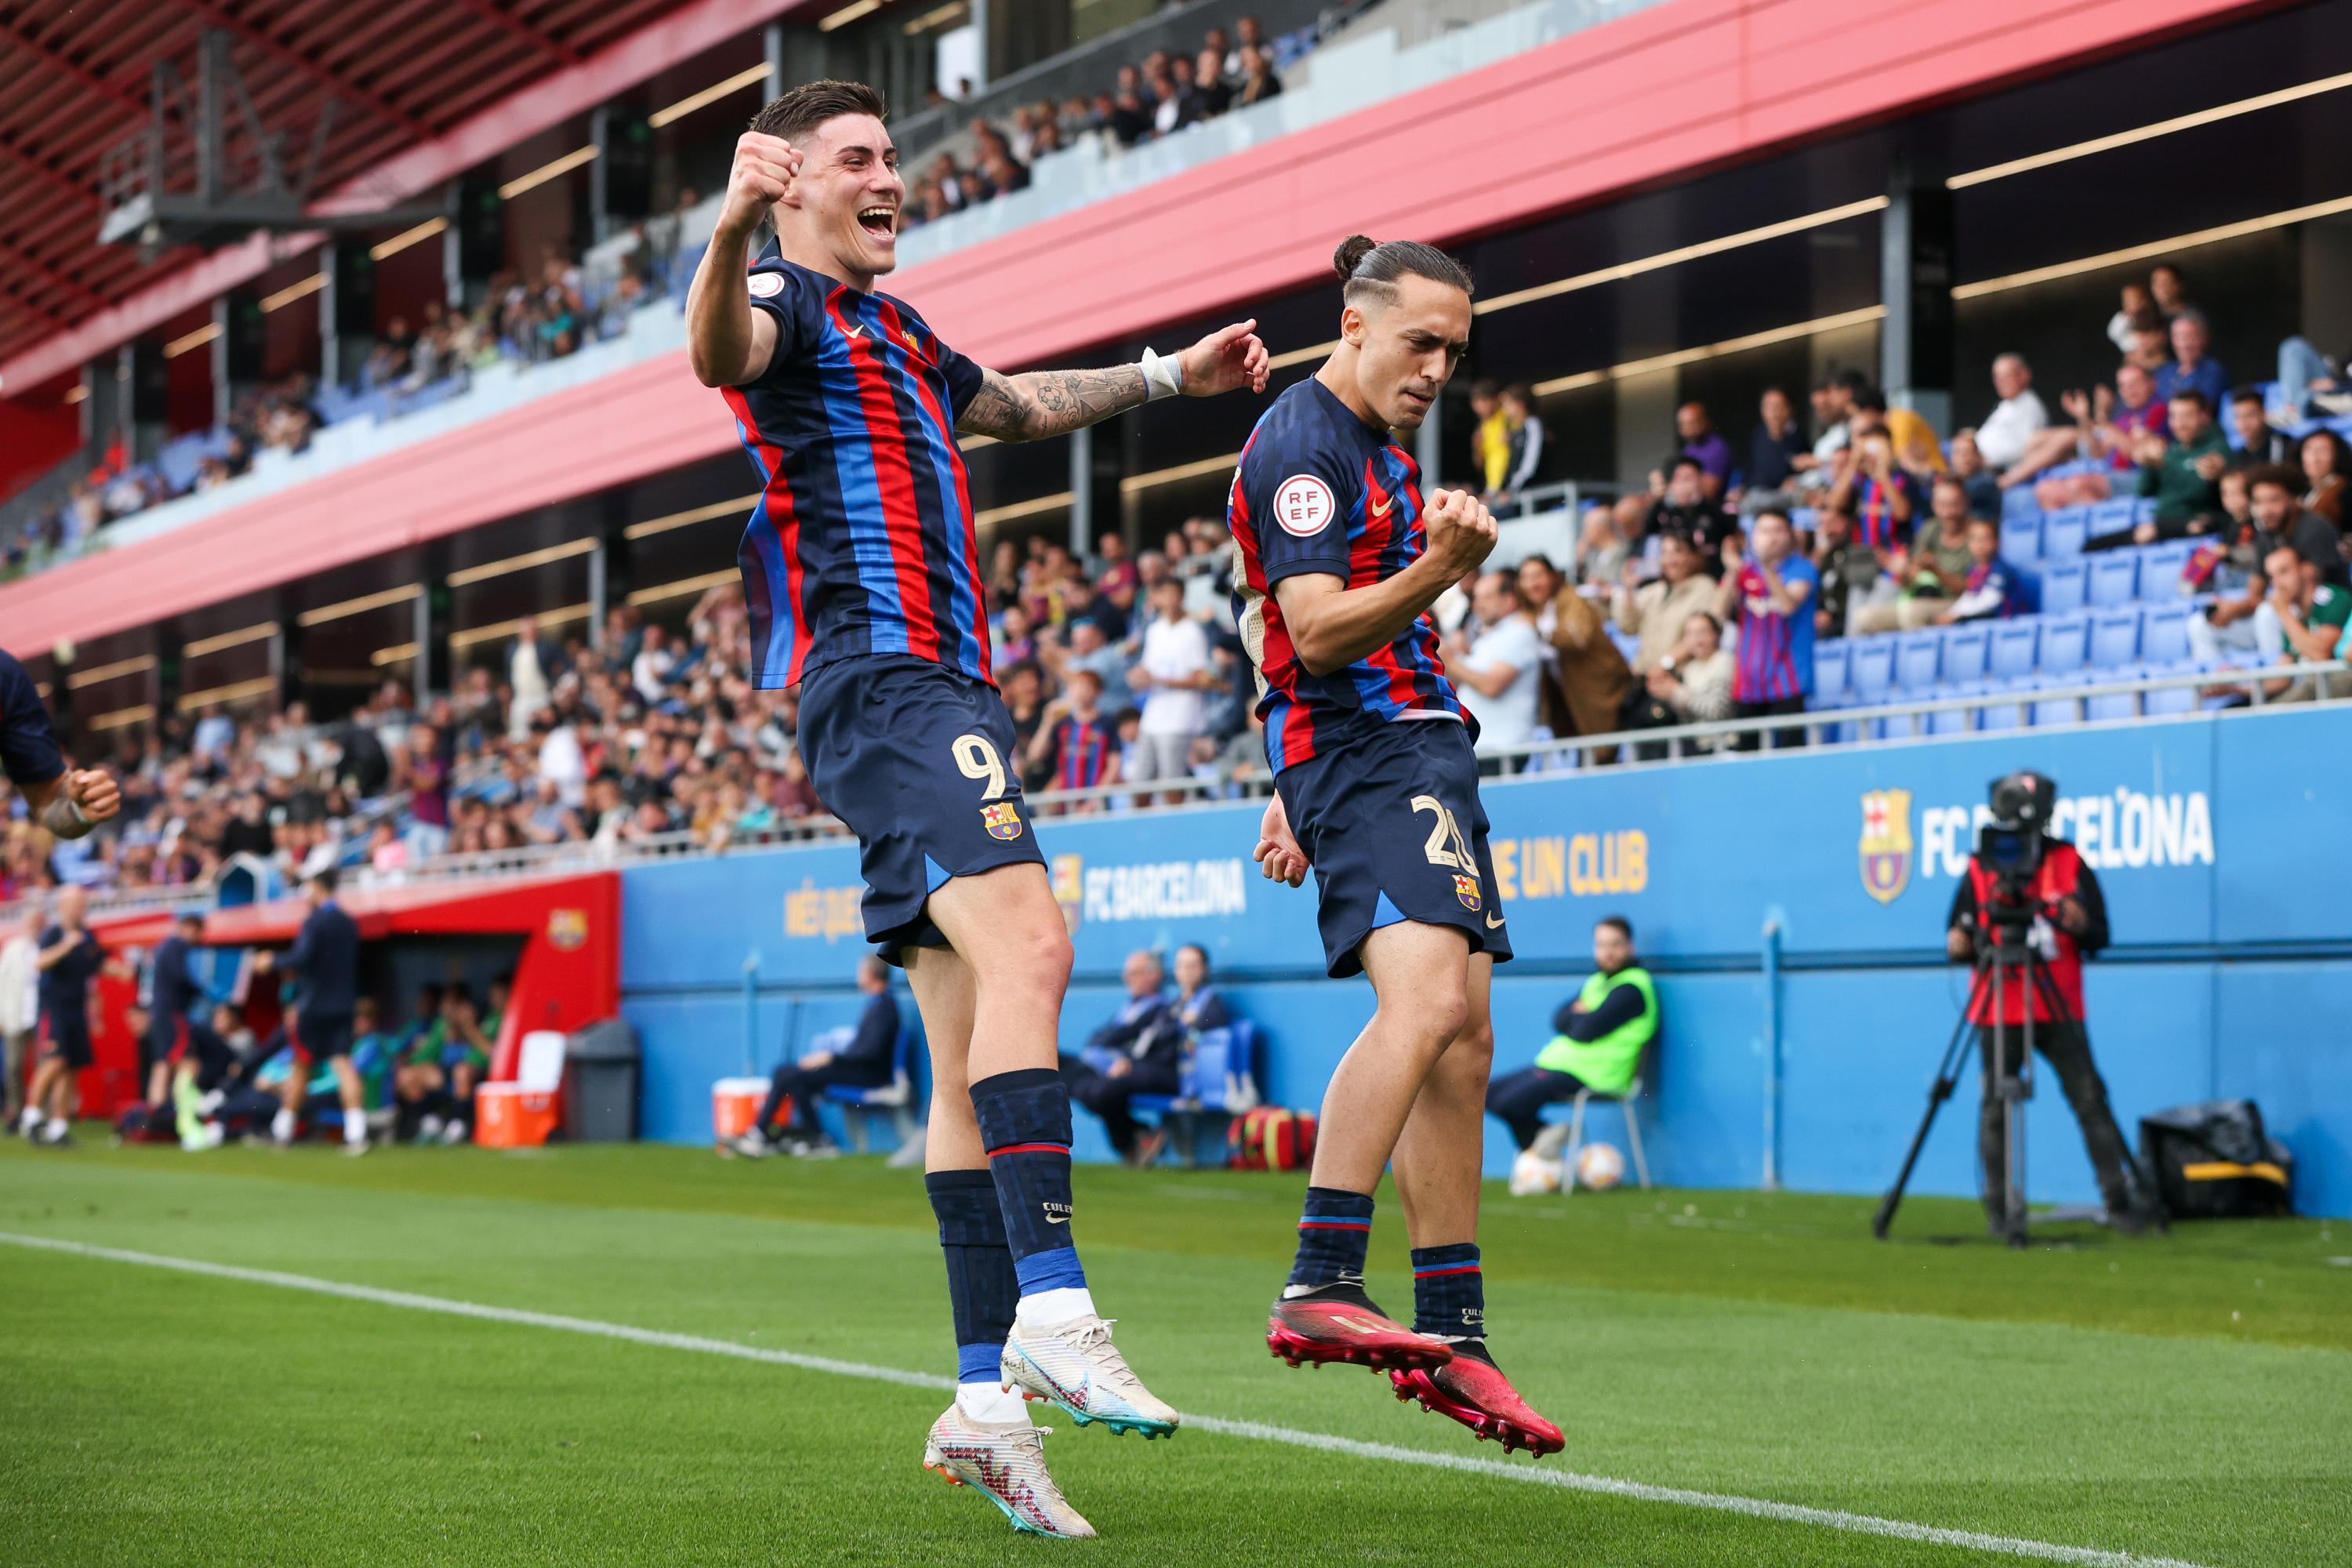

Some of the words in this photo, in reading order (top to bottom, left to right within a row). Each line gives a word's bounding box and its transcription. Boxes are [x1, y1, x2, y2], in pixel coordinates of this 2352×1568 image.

[951, 734, 1007, 800] 9
[1569, 829, 1648, 896] CLUB
[1921, 804, 1969, 878] FC
[1112, 857, 1245, 920] BARCELONA
